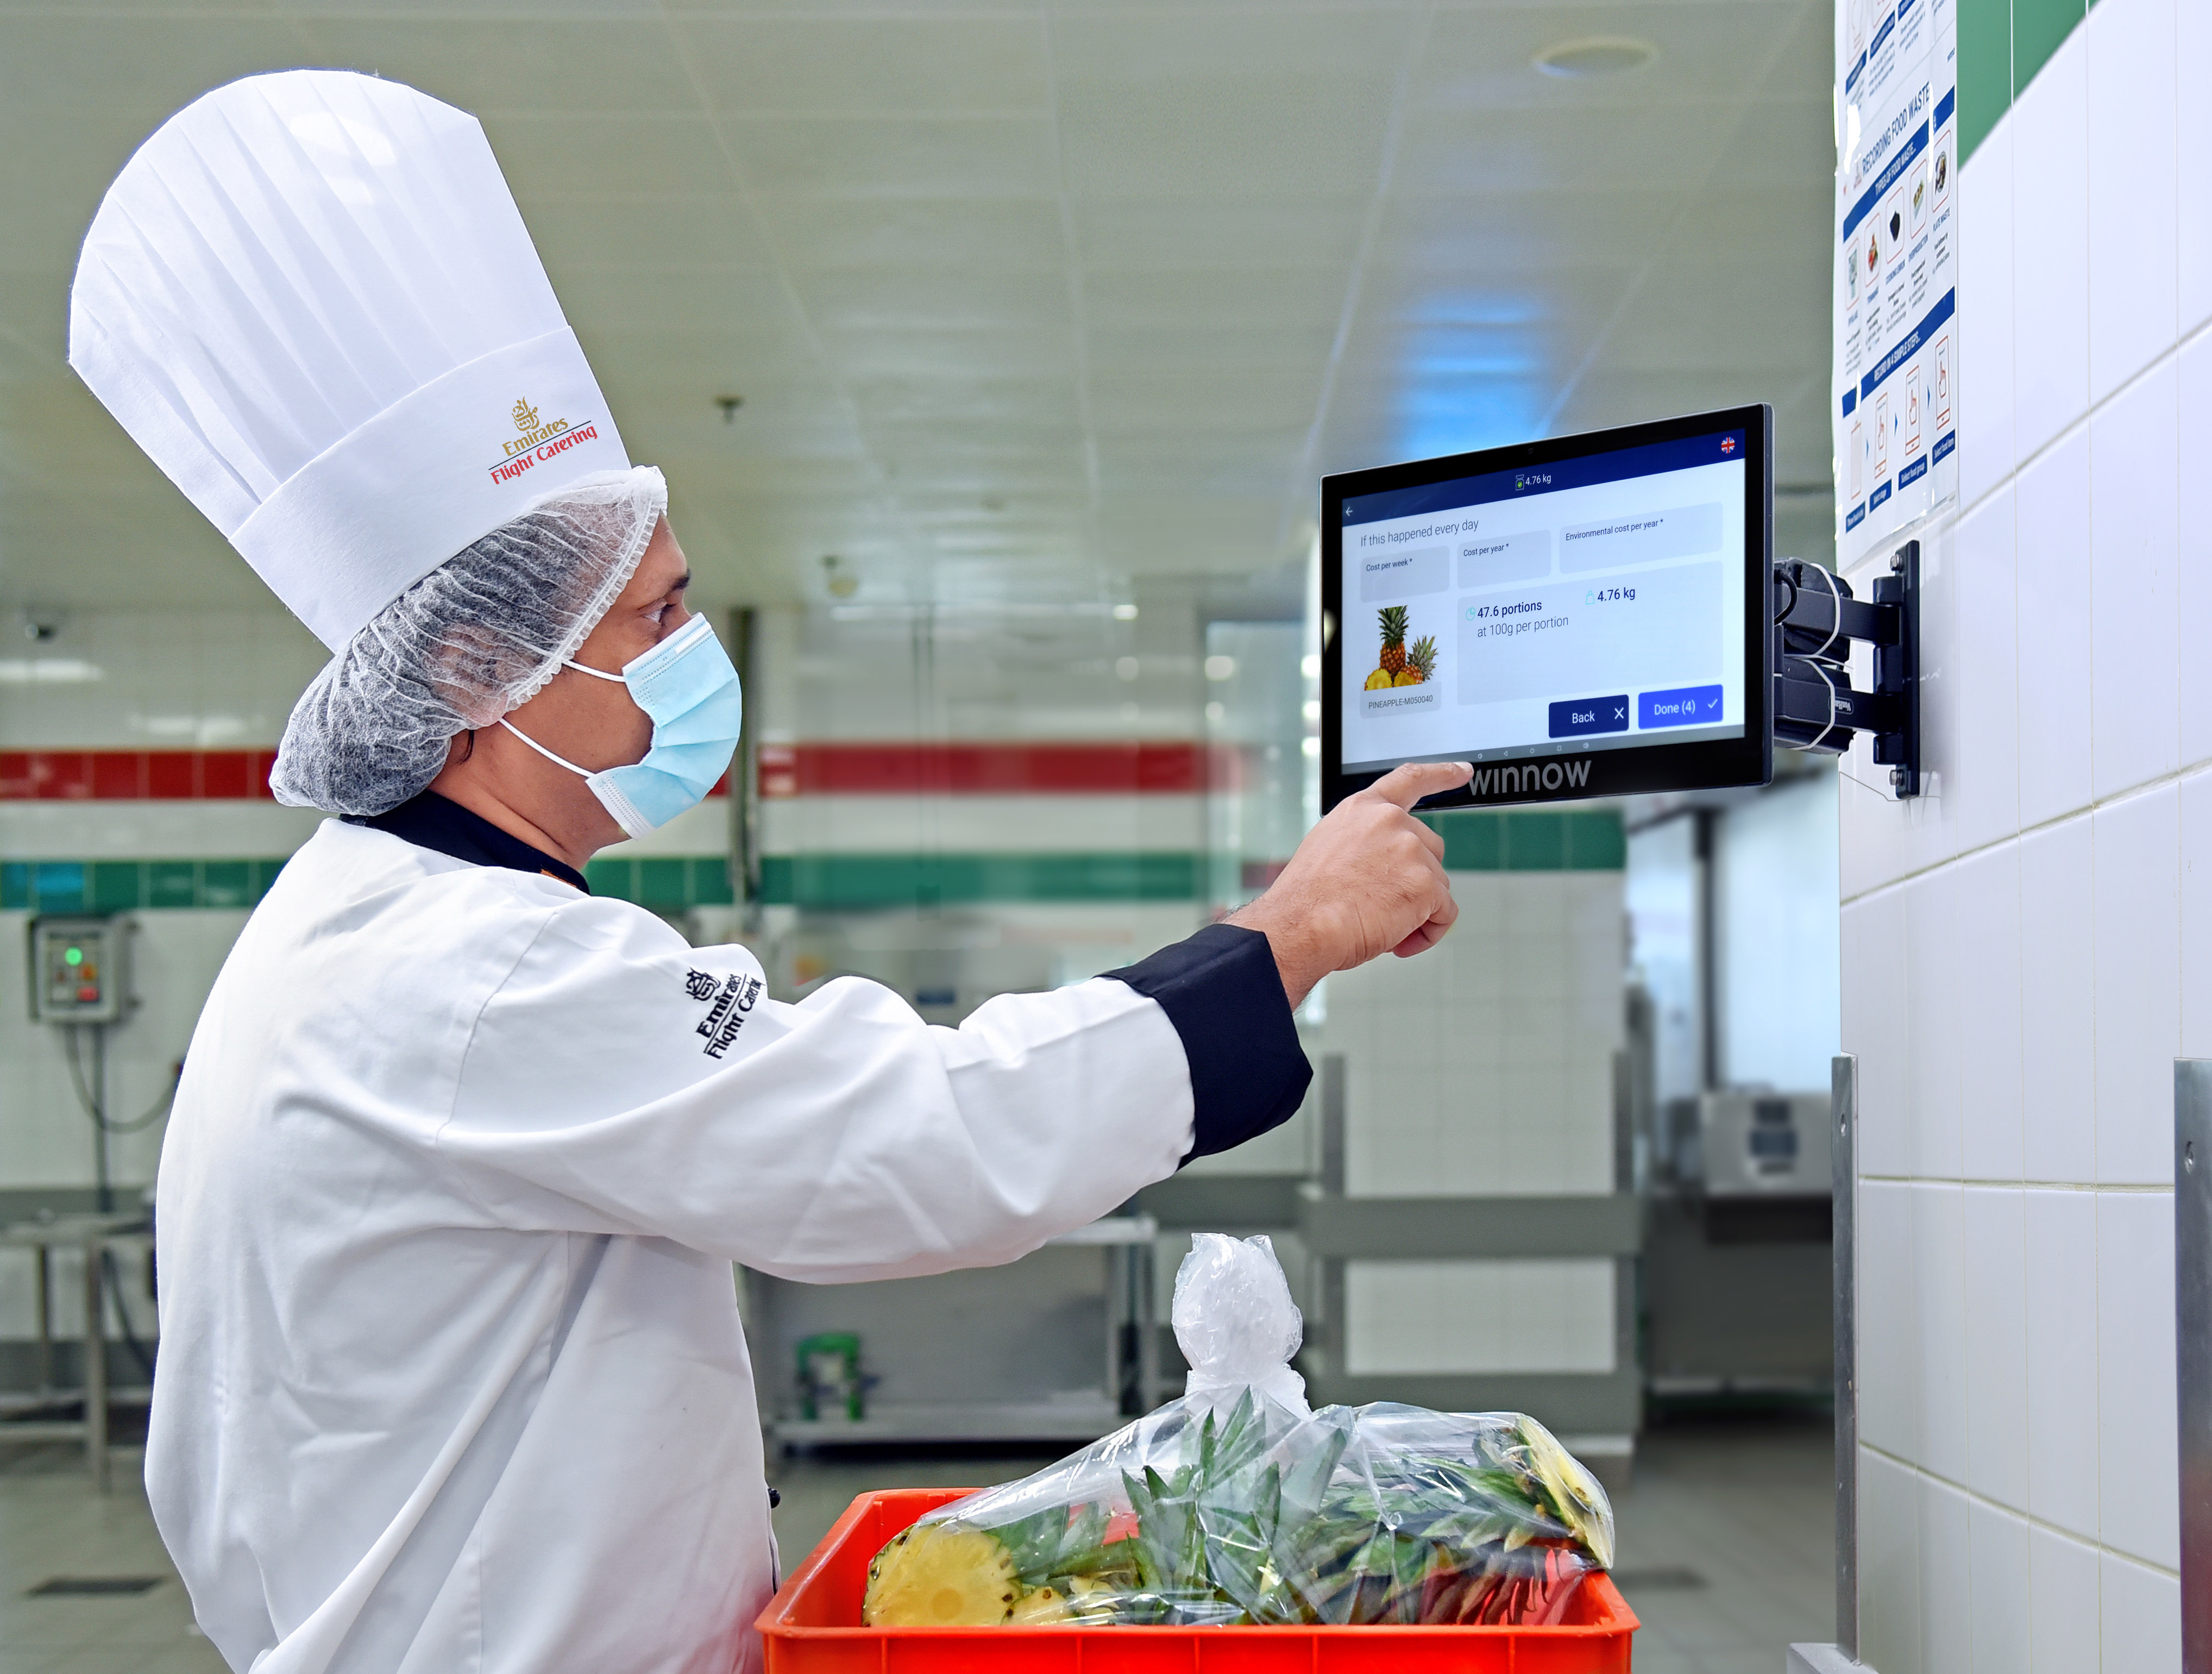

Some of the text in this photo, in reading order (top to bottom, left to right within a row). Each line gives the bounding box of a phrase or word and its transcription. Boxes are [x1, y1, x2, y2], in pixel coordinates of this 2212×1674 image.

[1862, 81, 1930, 176] RECORDING FOOD WASTE
[502, 418, 568, 456] Emirates
[491, 425, 598, 485] Flight Catering
[1525, 474, 1551, 485] 4.76 kg
[1361, 519, 1479, 547] If this happened every day
[1566, 519, 1658, 541] Environmental cost per year
[1463, 544, 1504, 557] Cost per year
[1366, 558, 1408, 572] Cost per week
[1597, 587, 1636, 602] 4.76 kg
[1477, 601, 1542, 618] 47.6 portions
[1477, 616, 1569, 637] at 100g per portion
[1368, 694, 1434, 709] PINEAPPLE-M050040
[1654, 700, 1696, 716] Done (4)
[1572, 711, 1595, 724] Back
[1468, 761, 1592, 795] winnow
[695, 974, 742, 1038] Emirates
[707, 1012, 745, 1059] Flight
